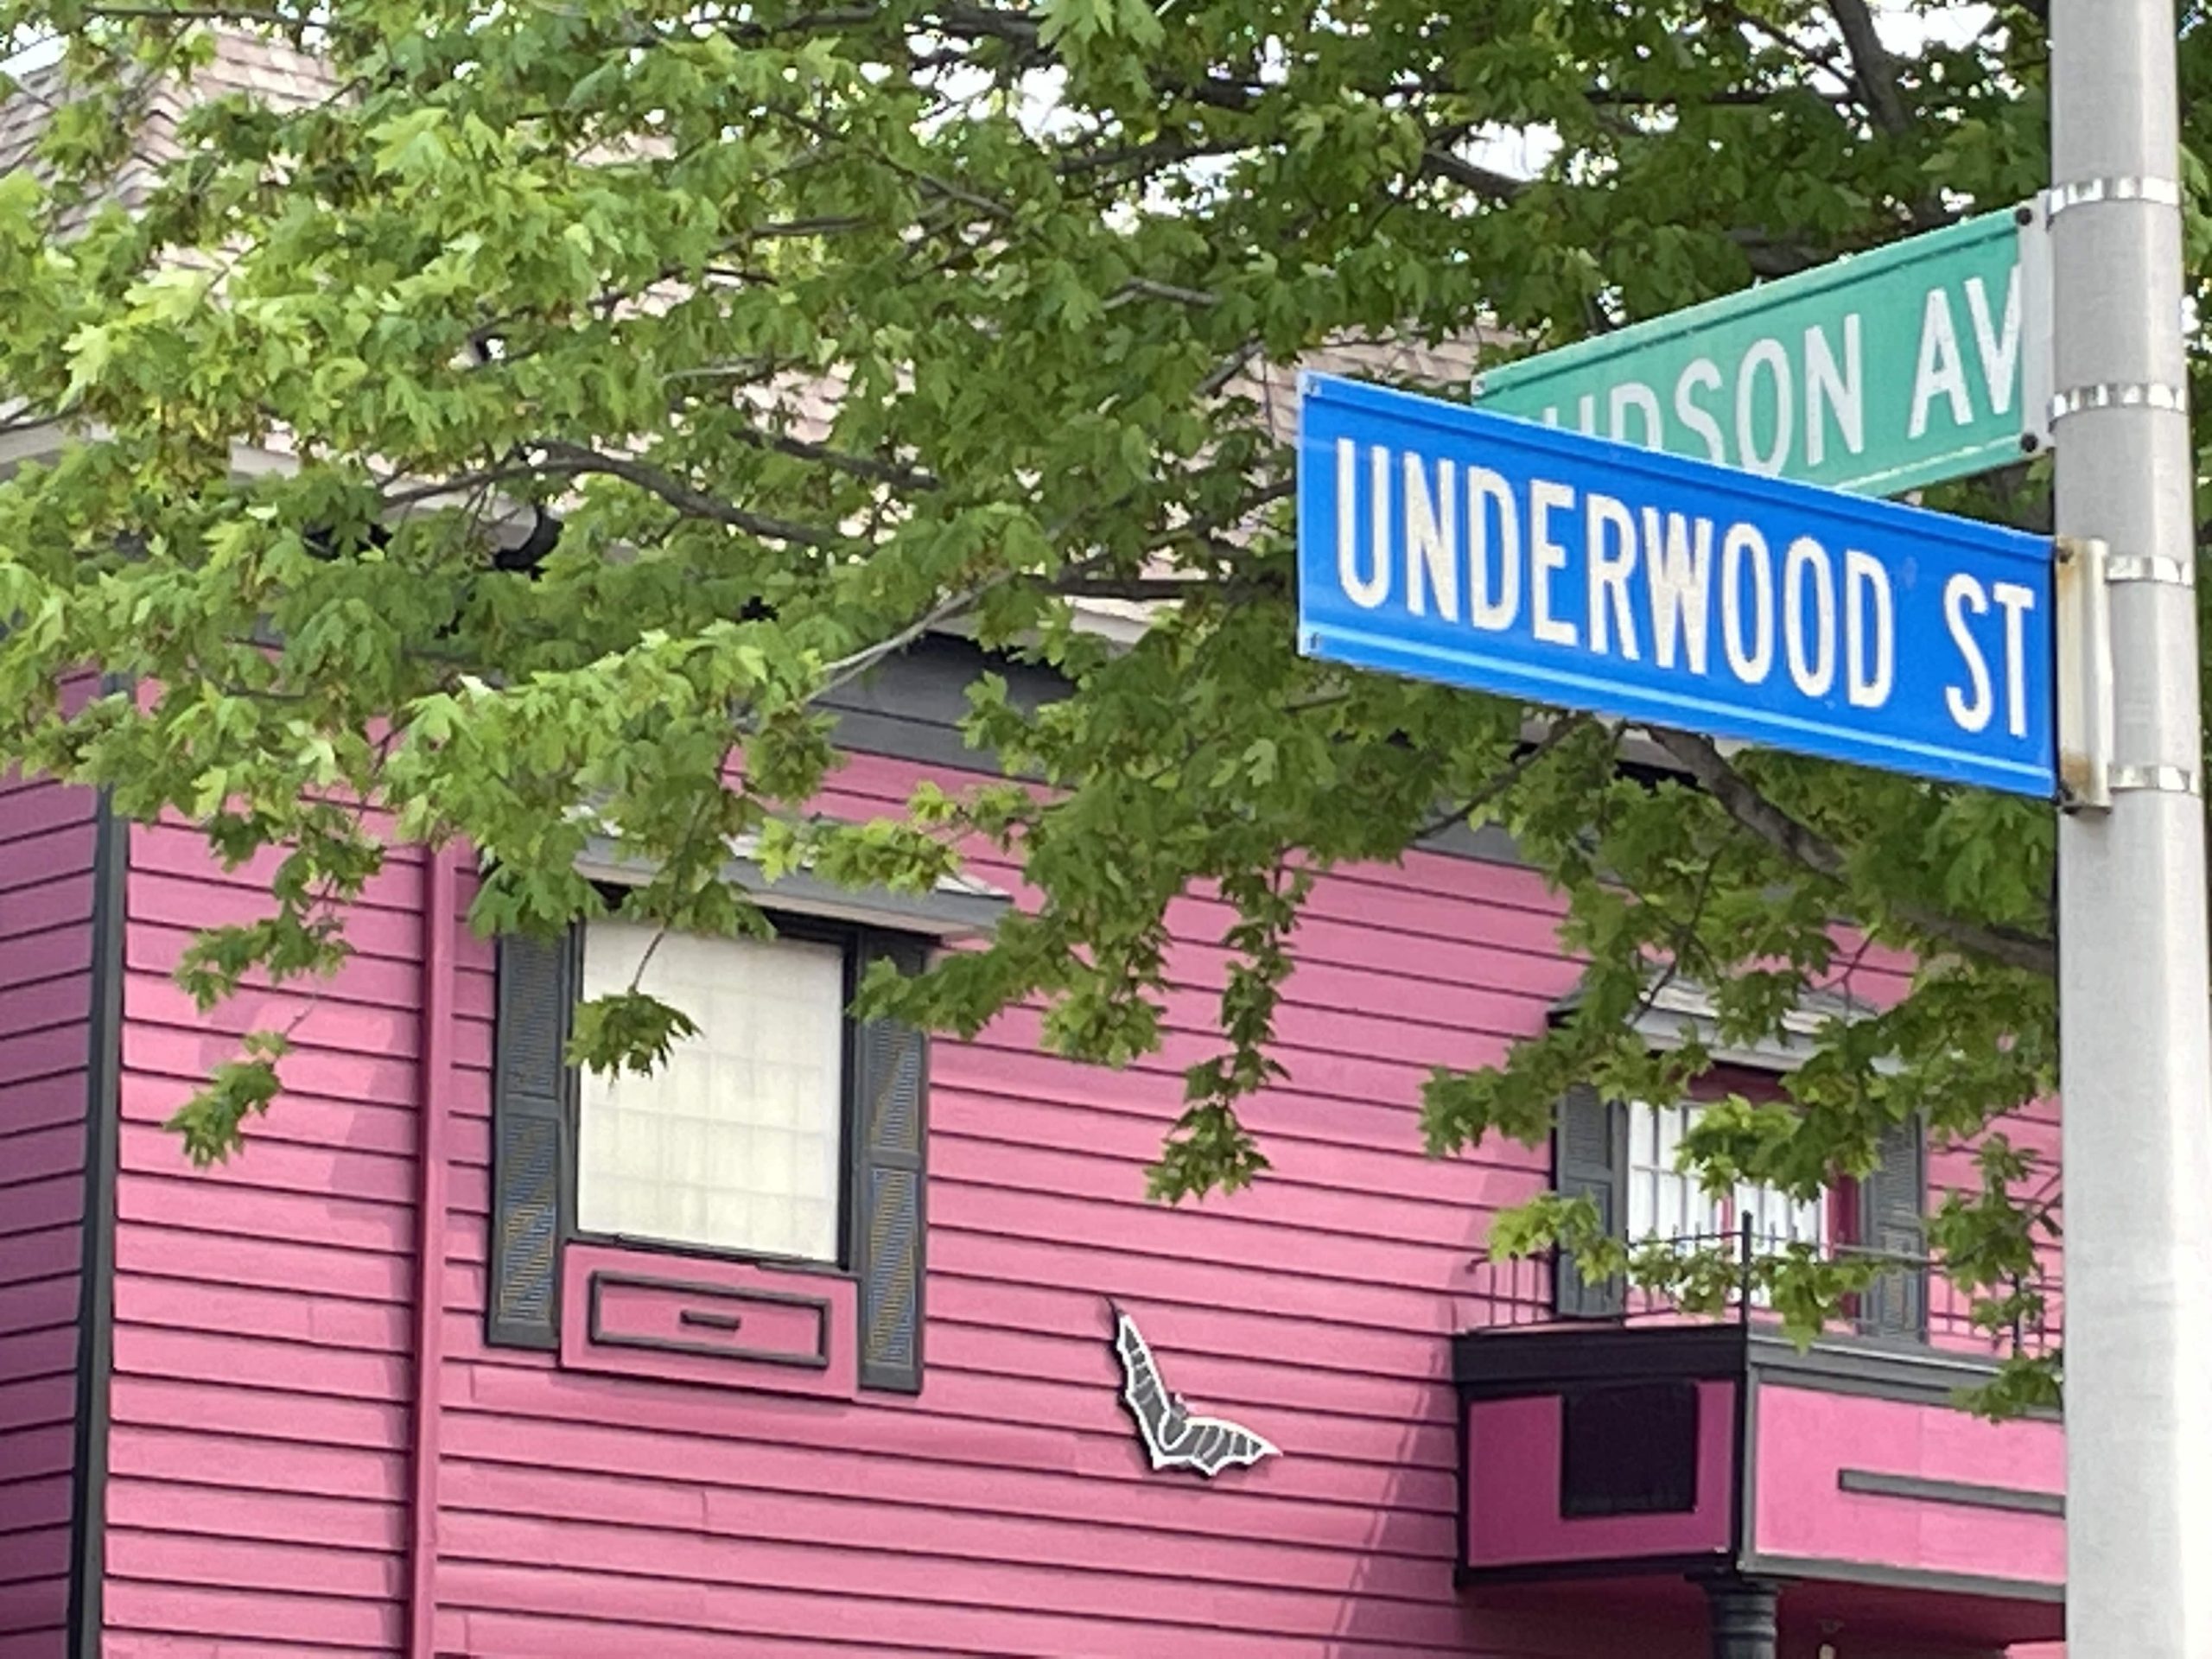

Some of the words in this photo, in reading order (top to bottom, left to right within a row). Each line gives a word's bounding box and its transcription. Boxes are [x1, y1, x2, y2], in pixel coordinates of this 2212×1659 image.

[1544, 313, 1863, 480] SON
[1908, 264, 2022, 440] AV
[1337, 437, 1894, 709] UNDERWOOD
[1942, 572, 2036, 738] ST
